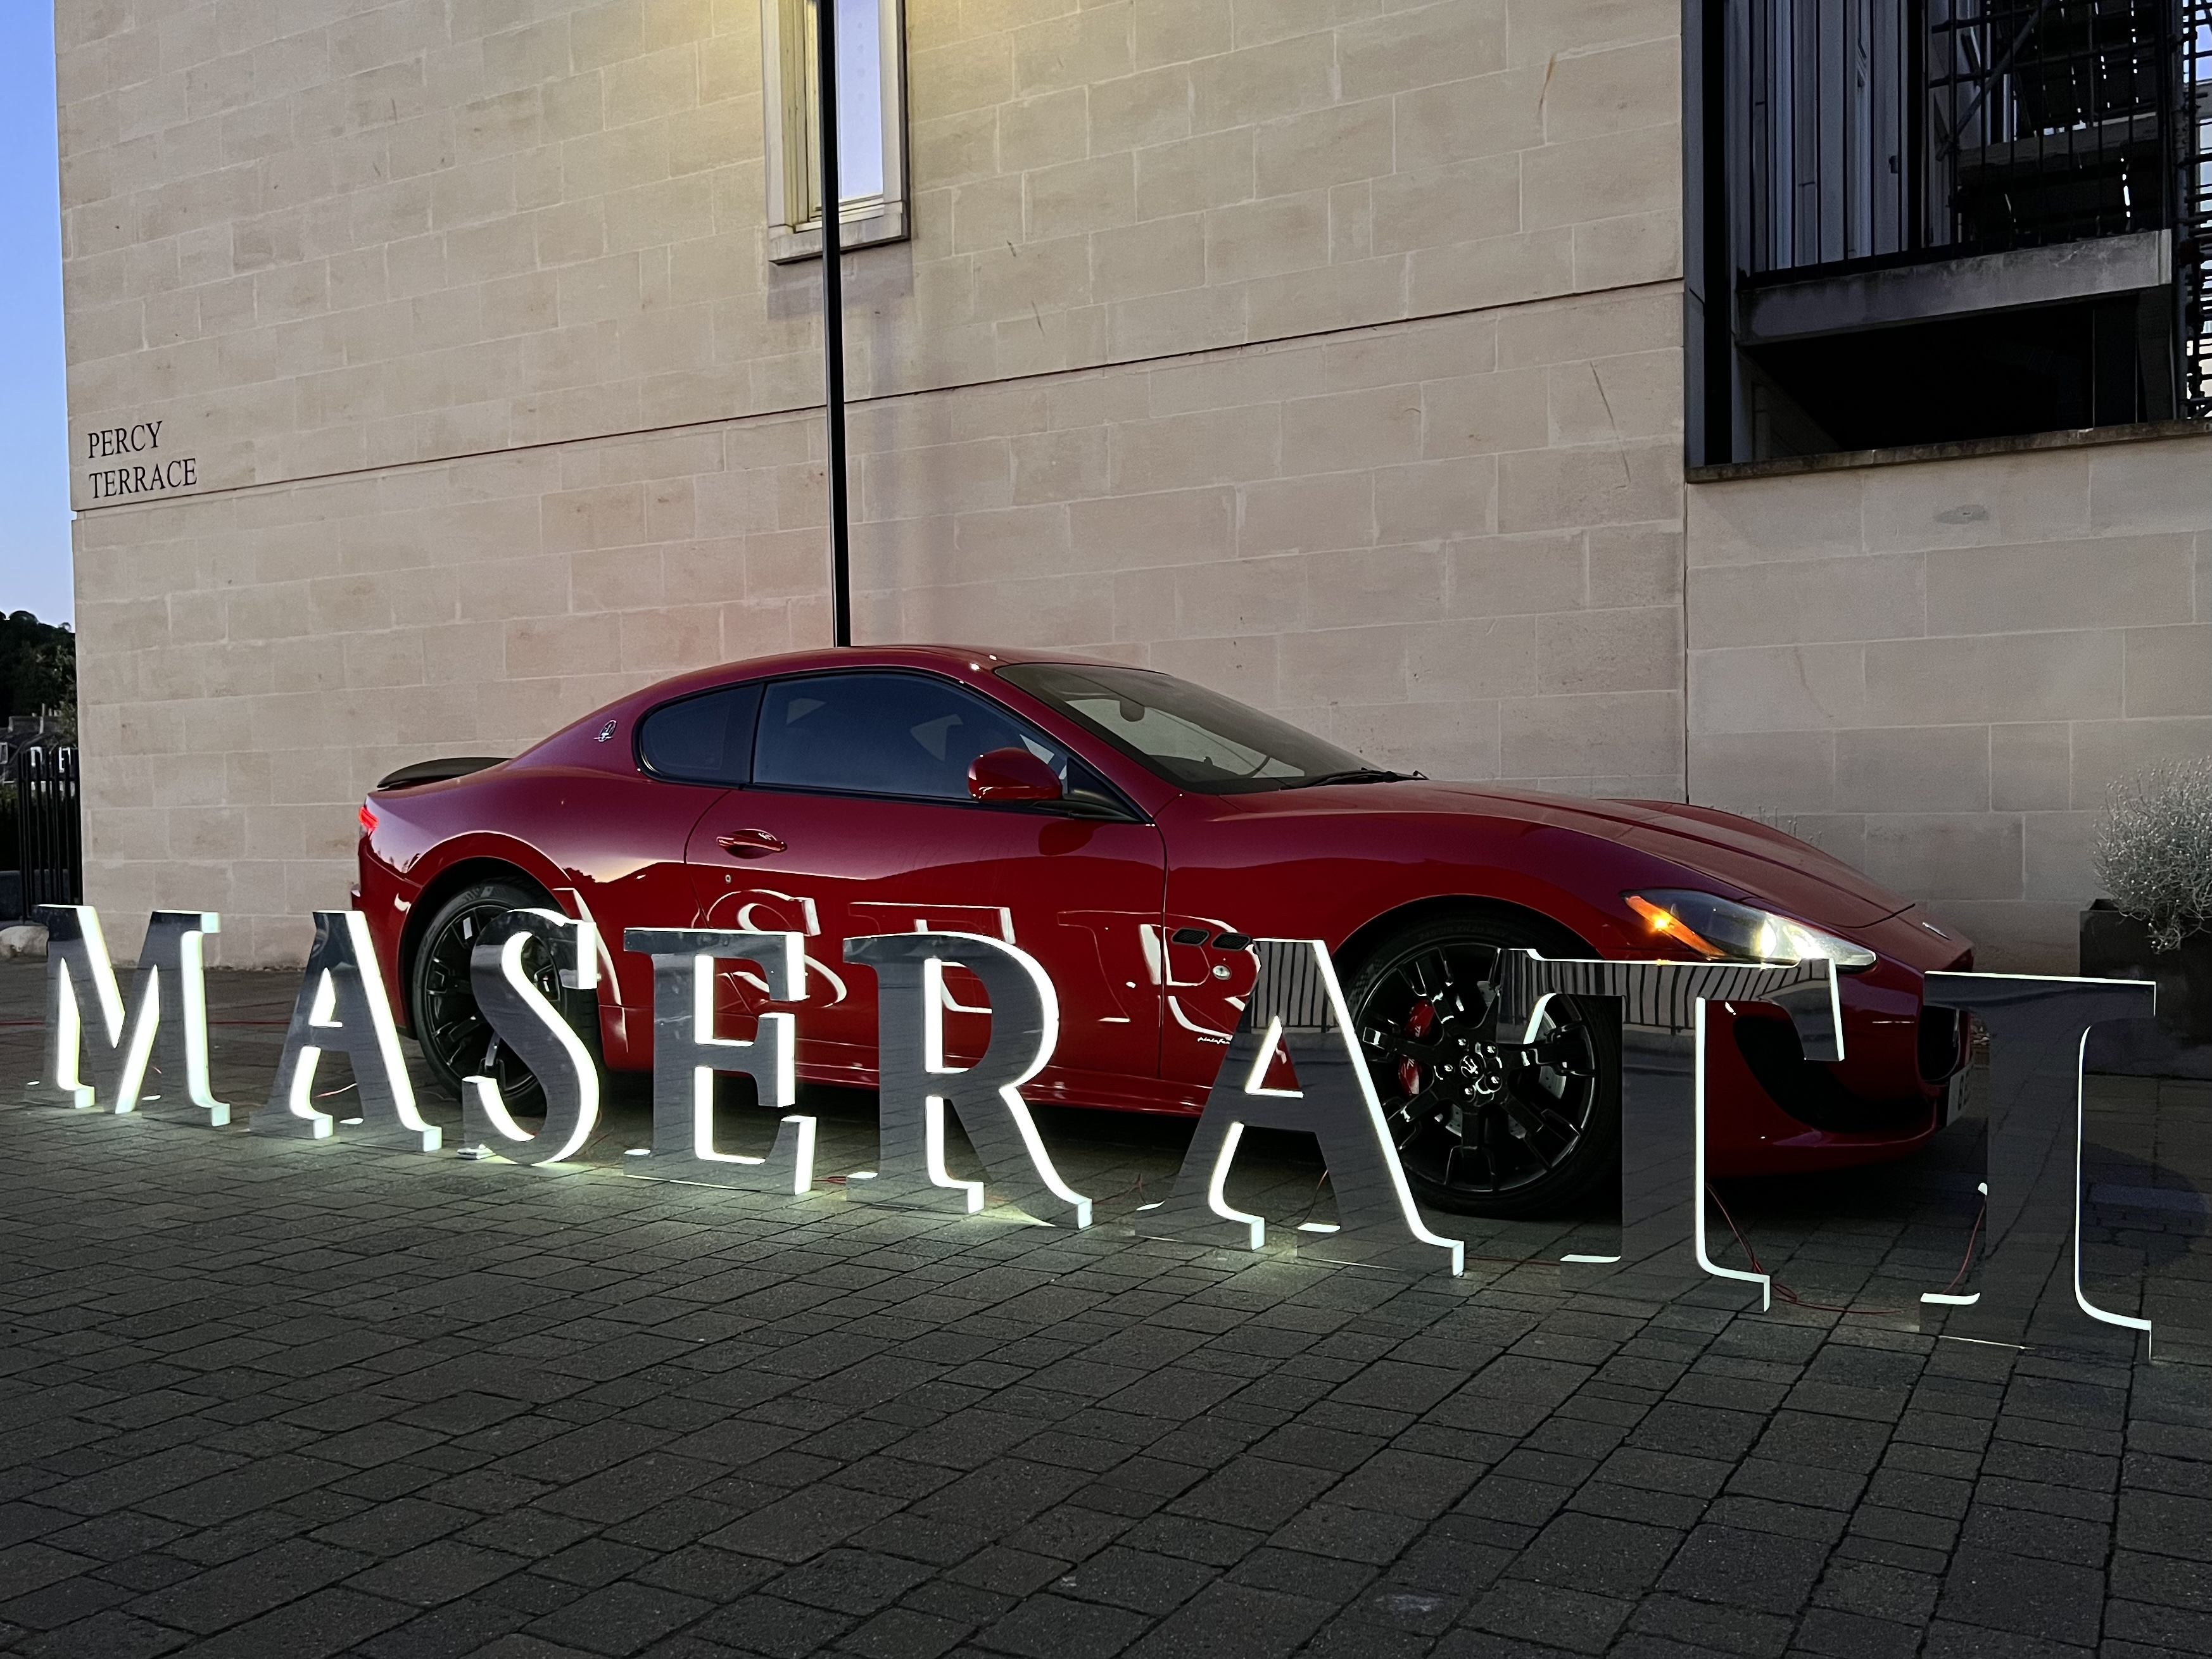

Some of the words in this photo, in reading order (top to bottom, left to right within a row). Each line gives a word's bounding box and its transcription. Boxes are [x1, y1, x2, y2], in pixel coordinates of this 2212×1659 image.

[87, 420, 163, 458] PERCY
[89, 458, 197, 498] TERRACE
[25, 904, 2156, 1360] MASERATI
